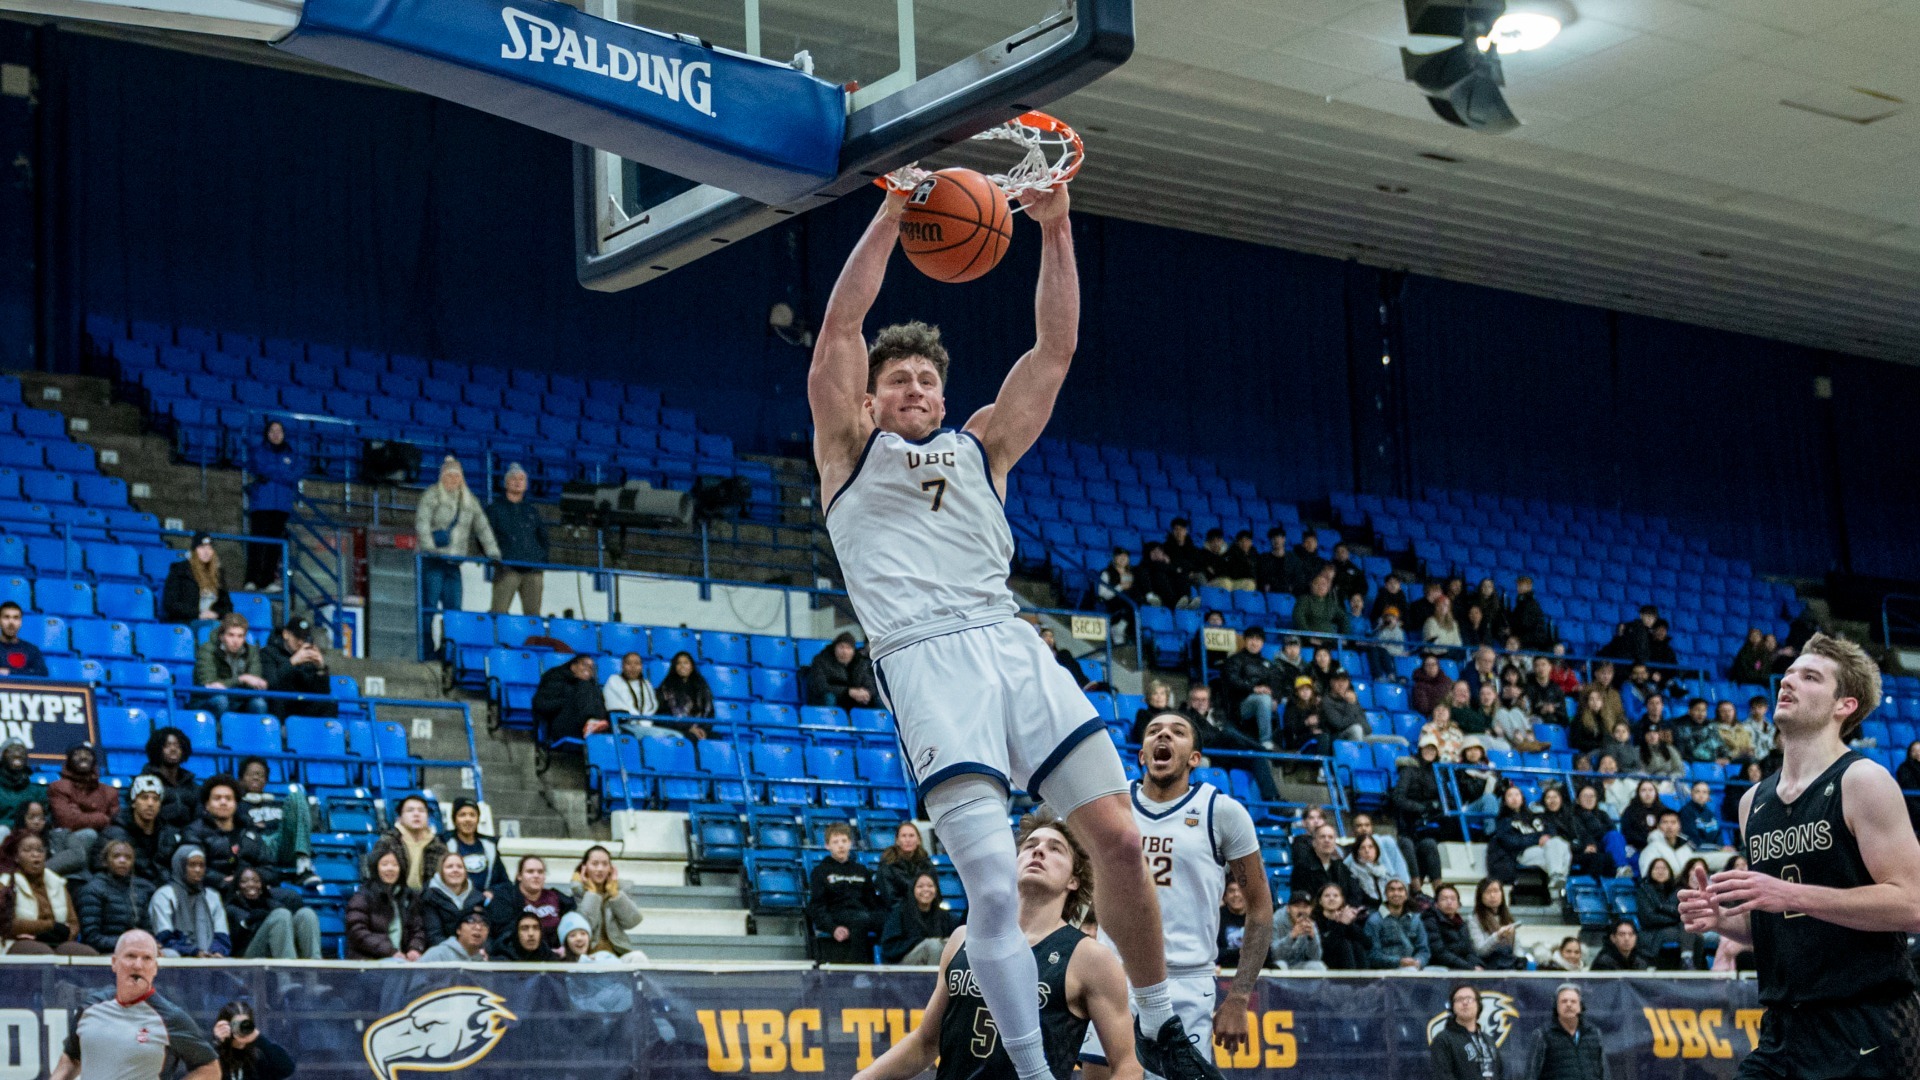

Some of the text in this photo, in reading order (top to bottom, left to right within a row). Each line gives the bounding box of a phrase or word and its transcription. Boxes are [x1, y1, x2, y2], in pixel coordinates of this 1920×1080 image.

[906, 451, 955, 469] UBC
[921, 477, 946, 512] 7
[0, 692, 86, 724] HYPE
[1749, 819, 1833, 865] BISONS
[1145, 856, 1172, 887] 2
[948, 969, 1052, 1010] BISS
[696, 1008, 825, 1073] UBC
[970, 1007, 998, 1058] 5
[1643, 1007, 1734, 1059] UBC
